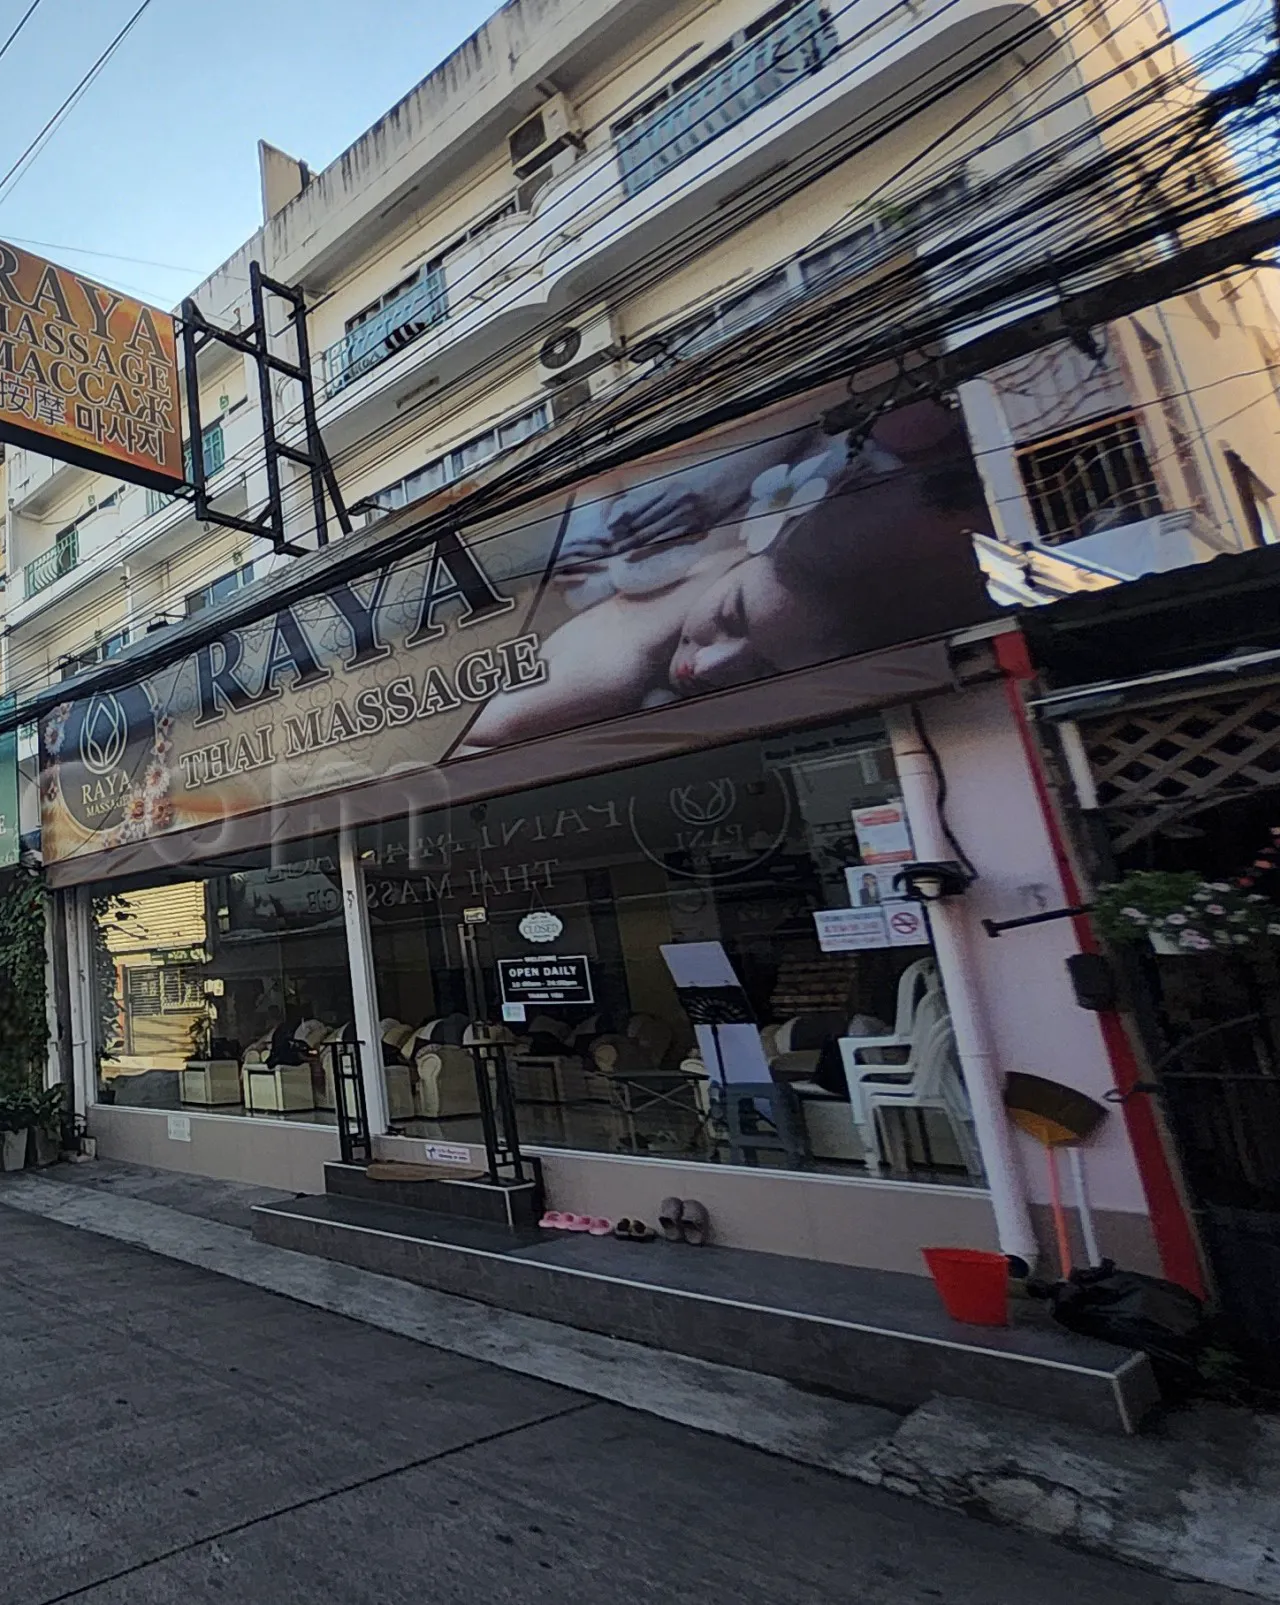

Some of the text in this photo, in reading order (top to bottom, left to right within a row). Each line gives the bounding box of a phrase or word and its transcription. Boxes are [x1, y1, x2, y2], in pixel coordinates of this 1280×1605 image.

[75, 403, 167, 465] 마사지
[191, 527, 517, 729] RAYA
[178, 633, 548, 791] THAI MASSAGE
[81, 770, 132, 805] RAYA
[508, 965, 577, 978] OPEN DAILY
